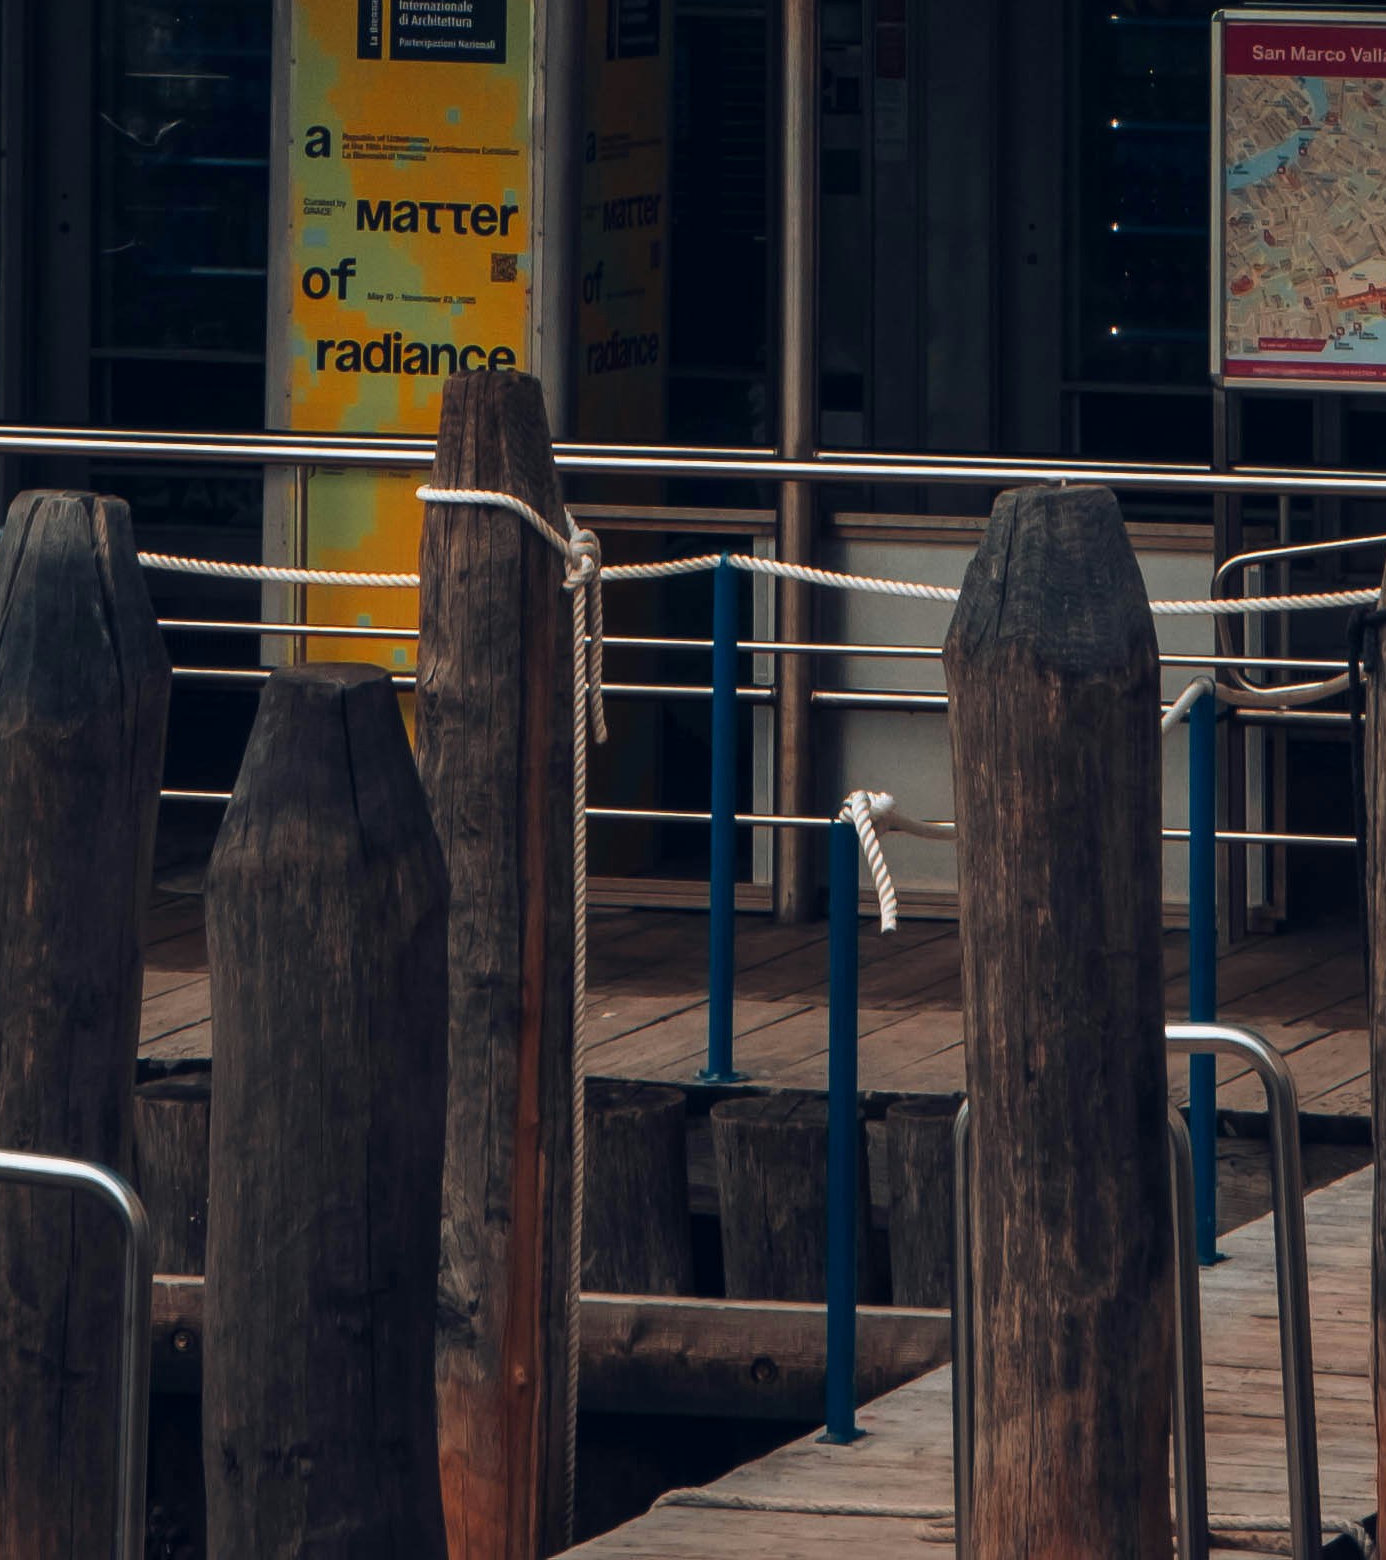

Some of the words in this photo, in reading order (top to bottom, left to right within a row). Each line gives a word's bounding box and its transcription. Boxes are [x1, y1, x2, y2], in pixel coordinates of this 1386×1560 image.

[399, 0, 474, 13] Internazionale
[399, 13, 409, 26] di
[411, 14, 473, 28] Architettura
[1252, 44, 1286, 61] San
[1291, 46, 1347, 62] Marco
[305, 125, 331, 159] a
[301, 258, 357, 300] of
[316, 331, 516, 375] radiance
